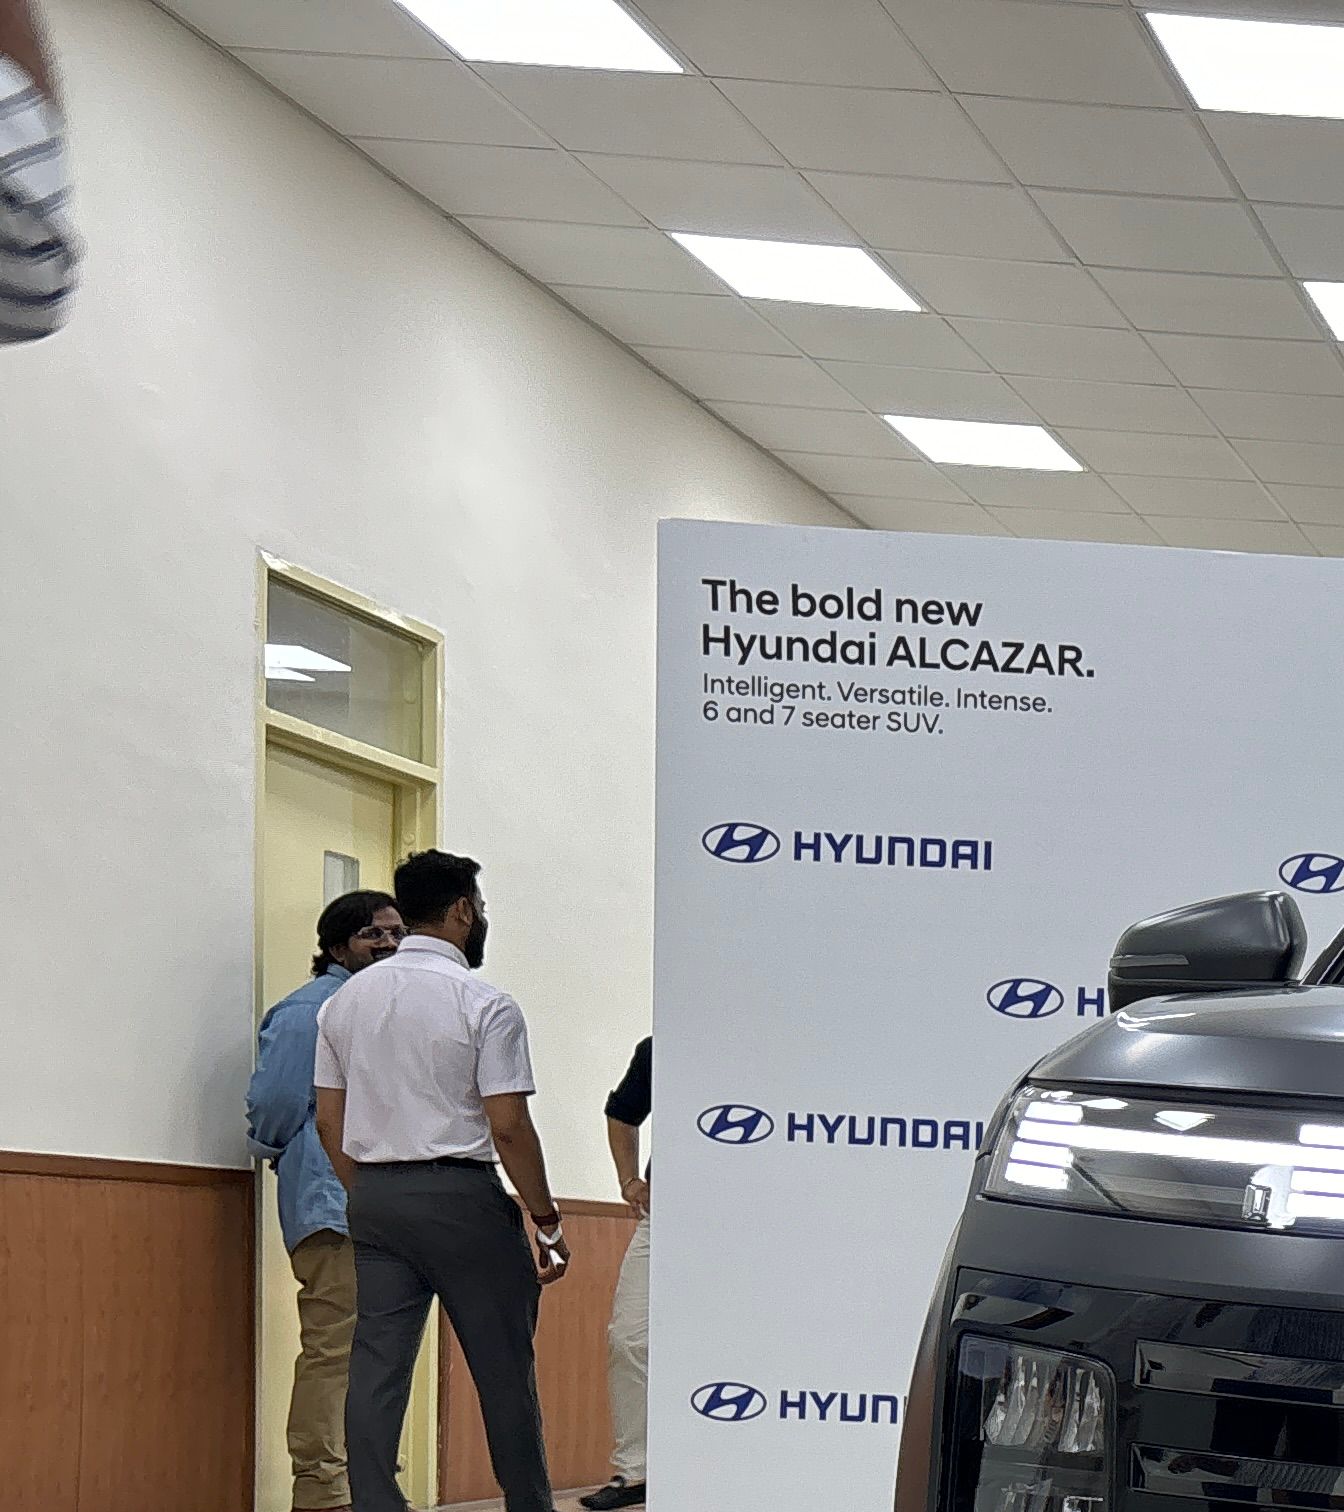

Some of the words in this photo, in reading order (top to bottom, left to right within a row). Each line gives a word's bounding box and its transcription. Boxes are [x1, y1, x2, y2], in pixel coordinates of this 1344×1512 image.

[702, 578, 780, 616] The
[791, 583, 882, 622] bold
[895, 598, 983, 627] new
[702, 624, 876, 666] Hyundai
[886, 635, 1095, 678] ALCAZAR.
[703, 672, 832, 704] Intelligent.
[836, 681, 950, 708] Versatile.
[956, 687, 1053, 713] Intense.
[702, 700, 719, 722] 6
[725, 703, 775, 725] and
[781, 705, 796, 726] 7
[801, 710, 881, 731] seater
[886, 711, 944, 735] SUV.
[793, 830, 993, 871] HYUNDAI
[787, 1112, 984, 1151] HYUNDAI
[779, 1390, 898, 1425] HYUN
